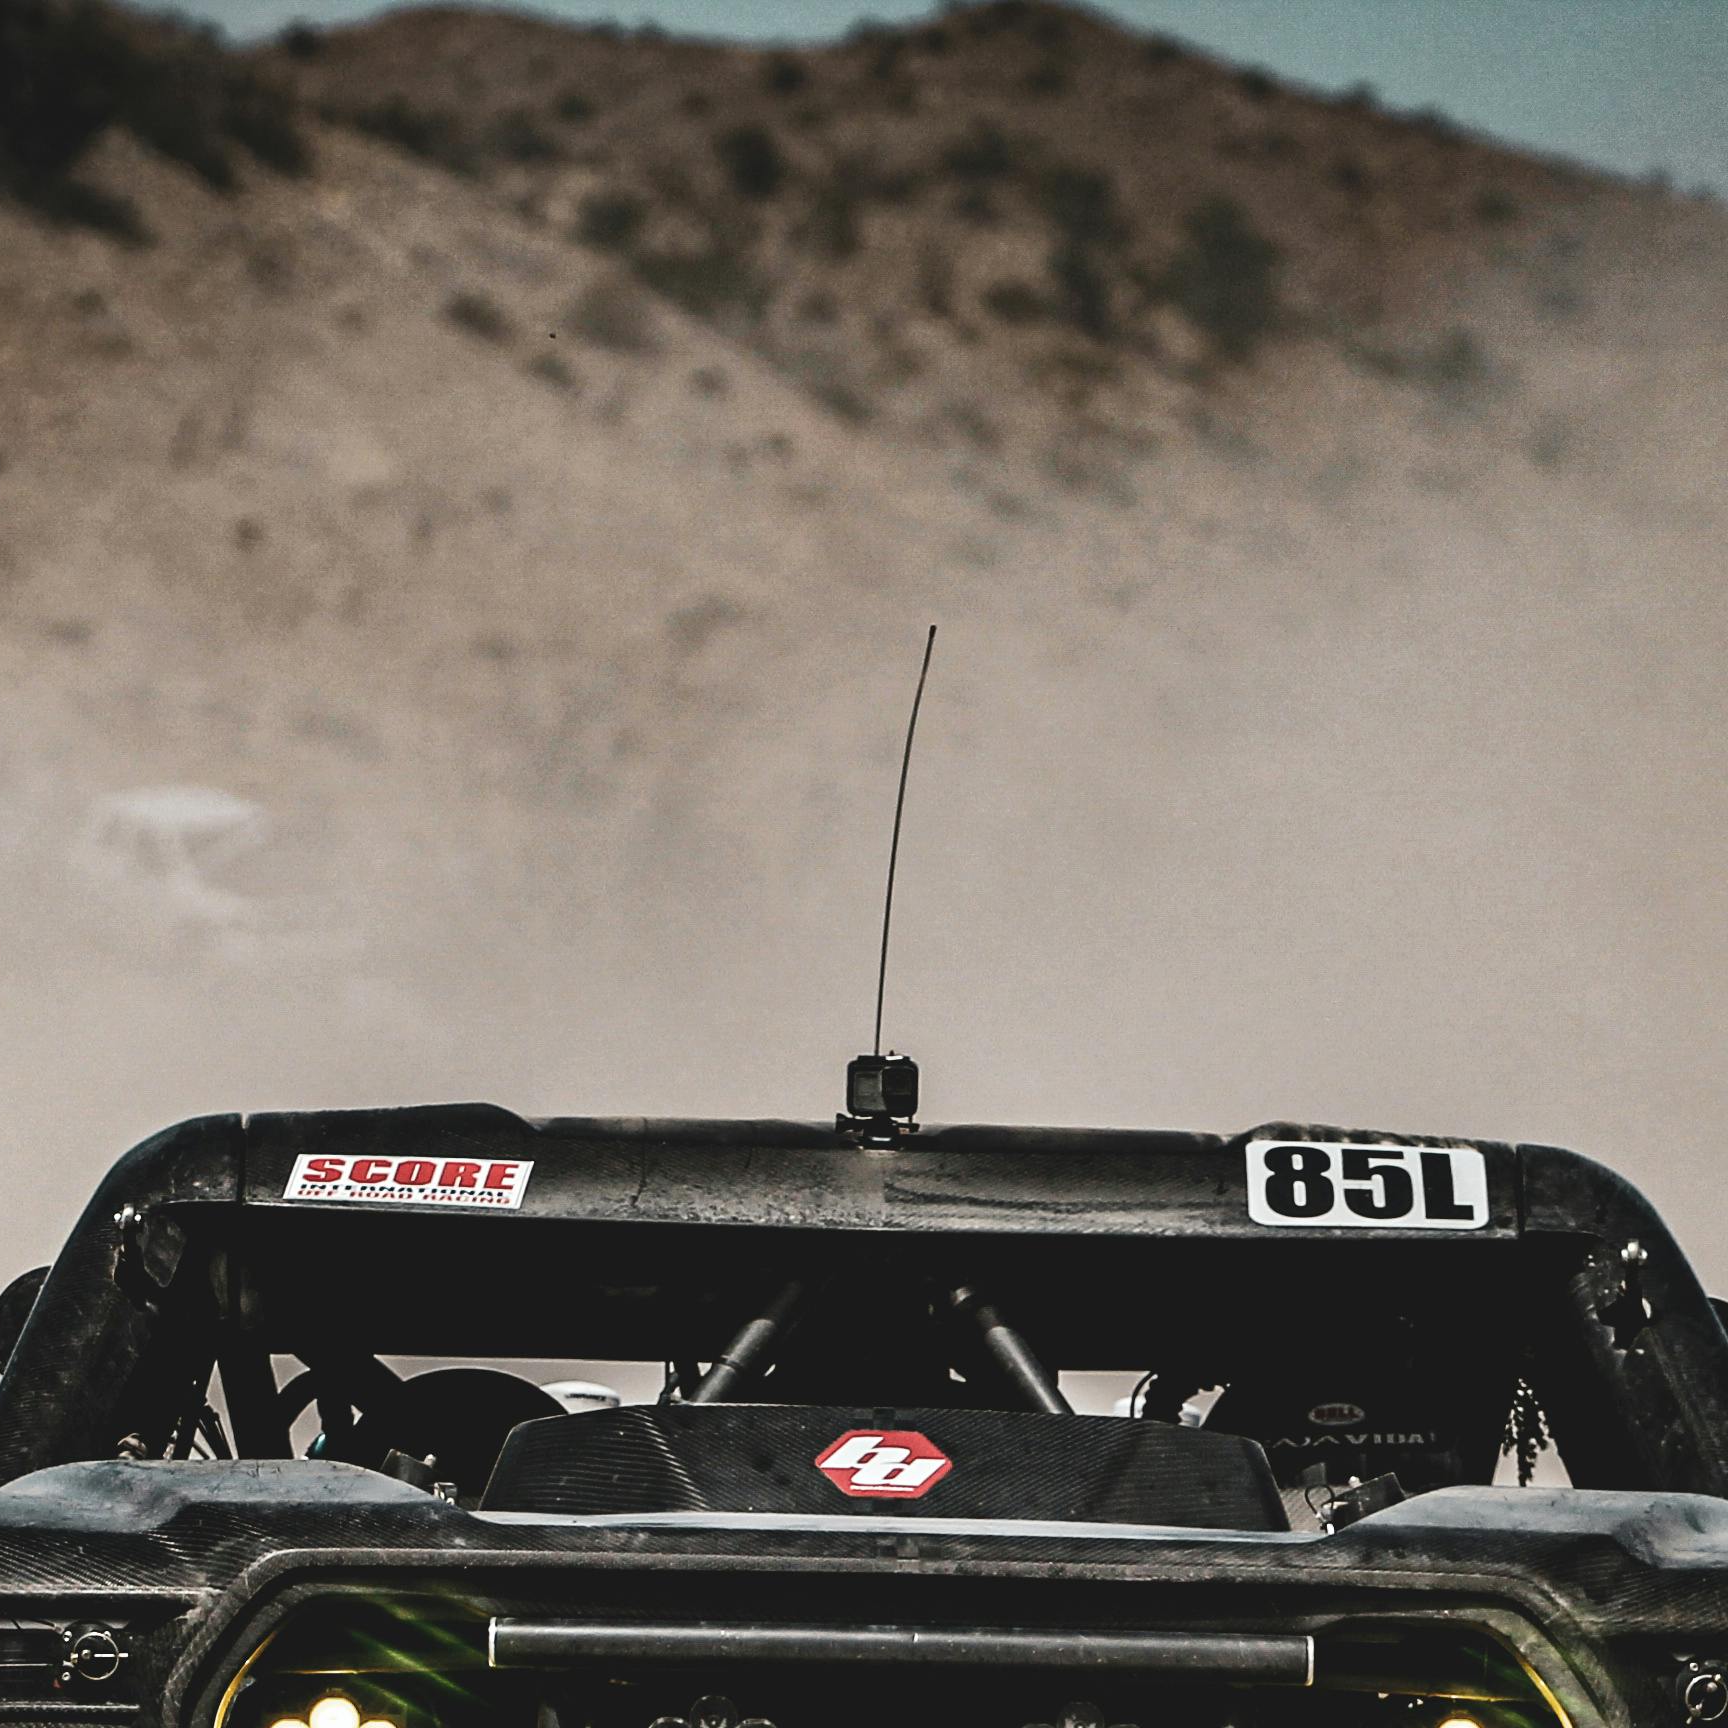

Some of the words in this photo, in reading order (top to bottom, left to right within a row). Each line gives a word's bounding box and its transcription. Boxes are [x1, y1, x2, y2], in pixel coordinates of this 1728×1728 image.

[302, 1158, 520, 1190] SCORE
[1264, 1145, 1475, 1220] 85L
[300, 1184, 511, 1197] INTERNATIONAL
